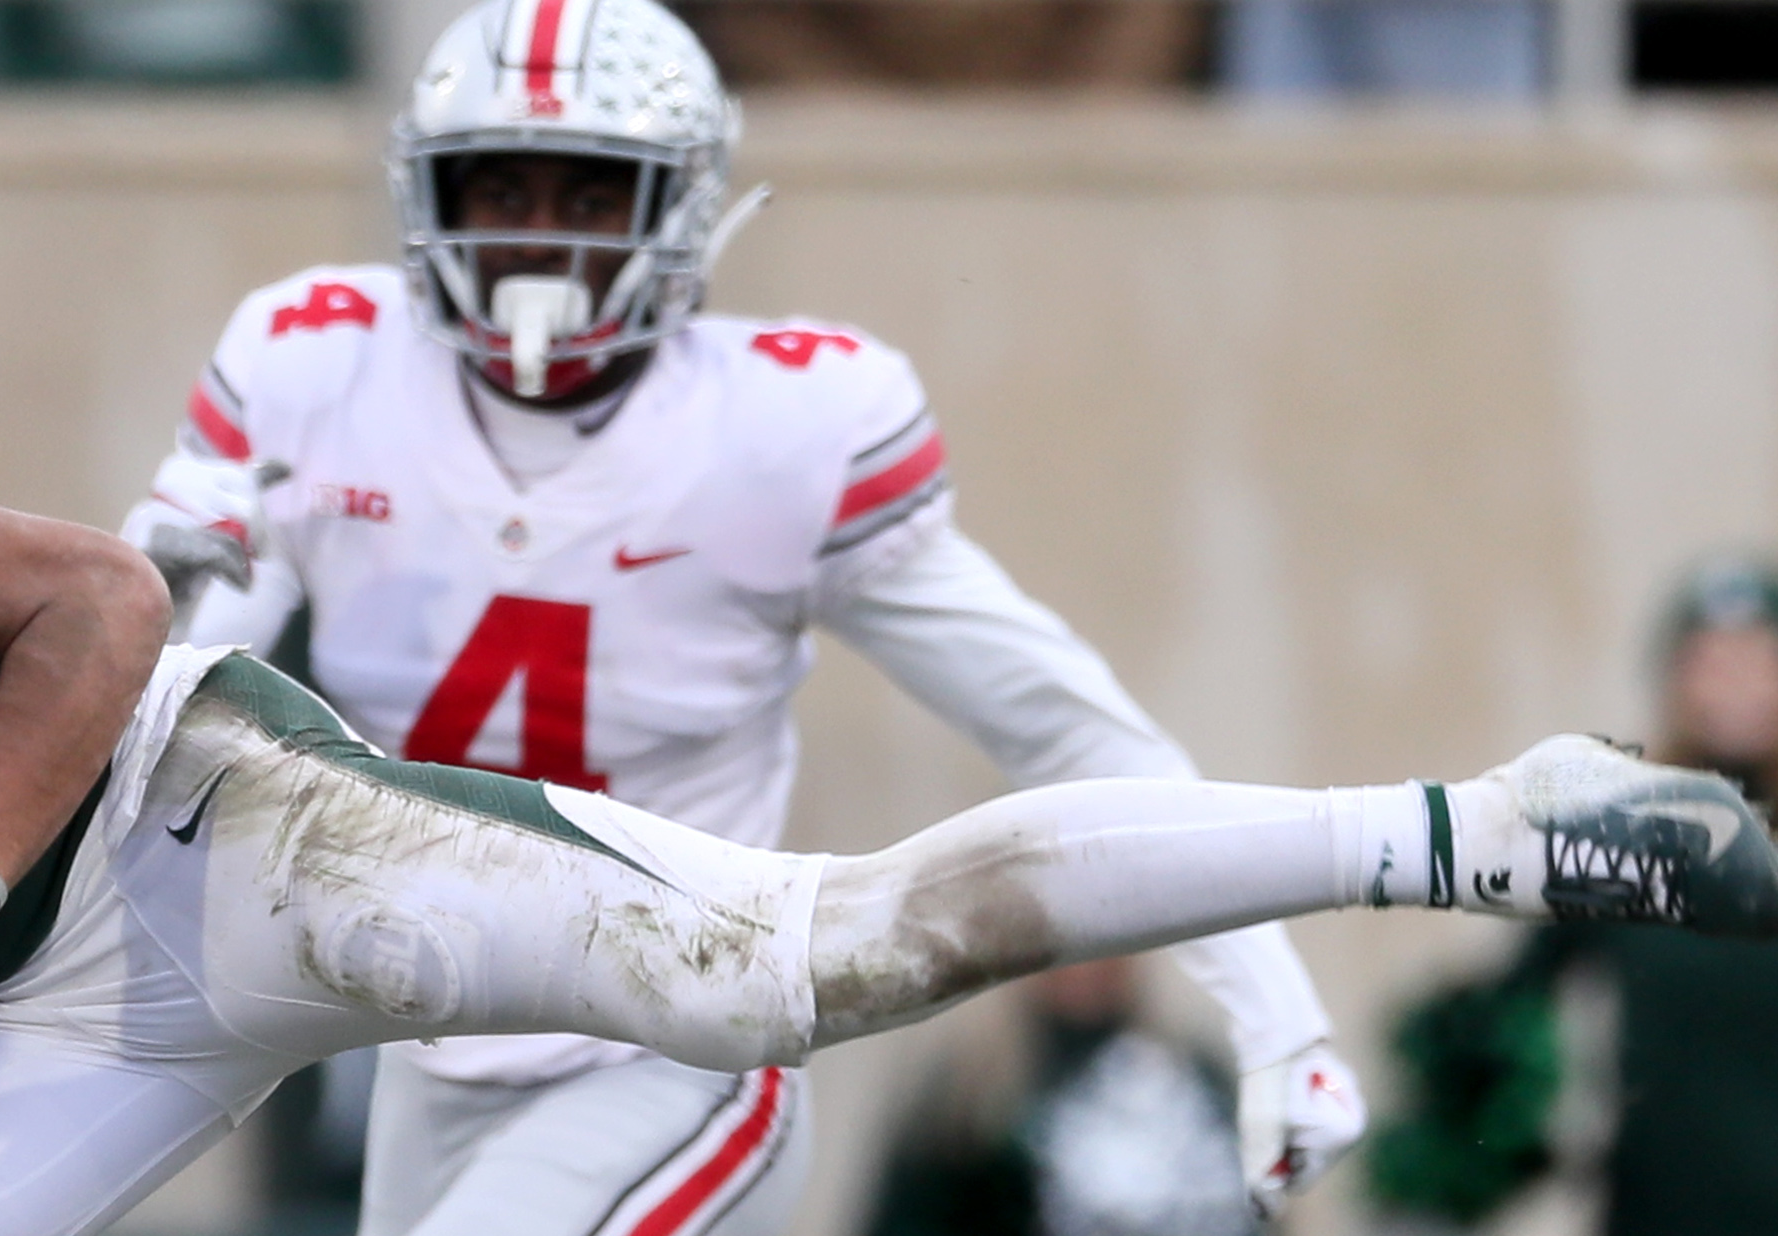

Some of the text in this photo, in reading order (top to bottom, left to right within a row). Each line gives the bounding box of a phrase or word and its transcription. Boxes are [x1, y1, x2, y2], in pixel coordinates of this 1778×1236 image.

[269, 282, 377, 337] 4
[749, 330, 860, 370] 4
[403, 594, 610, 794] 4
